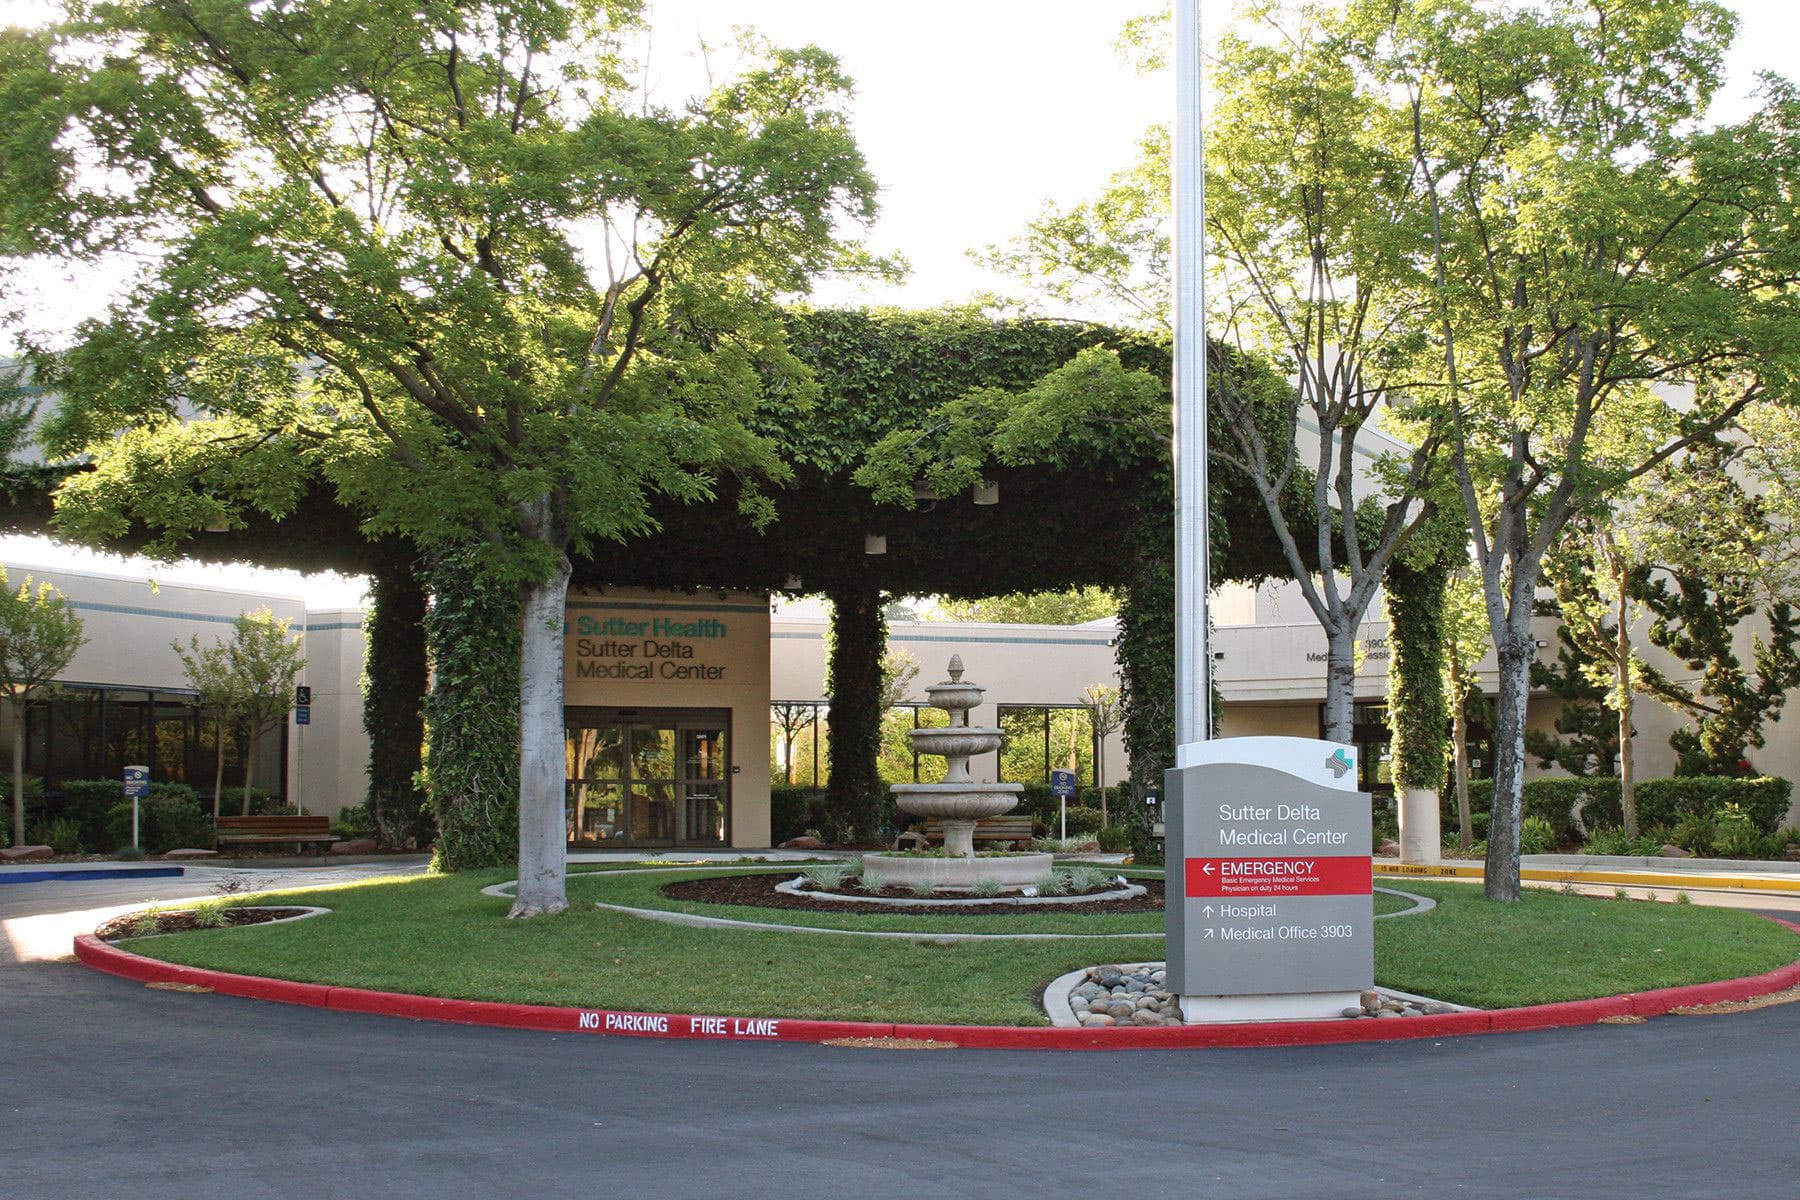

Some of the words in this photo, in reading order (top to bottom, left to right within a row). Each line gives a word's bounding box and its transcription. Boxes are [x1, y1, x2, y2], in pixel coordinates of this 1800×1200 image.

[577, 615, 649, 637] Sutter
[653, 618, 727, 638] Health
[577, 639, 638, 658] Sutter
[643, 640, 694, 659] Delta
[576, 660, 654, 679] Medical
[660, 661, 726, 680] Center
[1219, 804, 1272, 821] Sutter
[1277, 804, 1320, 821] Delta
[1219, 829, 1287, 845] Medical
[1293, 829, 1349, 845] Center
[1221, 861, 1315, 875] EMERGENCY
[1441, 868, 1457, 876] ZONE
[1221, 876, 1238, 884] Basic
[1239, 876, 1271, 885] Emergency
[1221, 885, 1250, 893] Physician
[1220, 904, 1277, 920] Hospital
[1221, 927, 1274, 940] Medical
[1278, 926, 1317, 939] Office
[1321, 925, 1353, 938] 3903
[579, 1012, 599, 1029] NO
[606, 1014, 668, 1032] PARKING
[690, 1017, 727, 1034] FIRE
[735, 1019, 779, 1036] LANE
